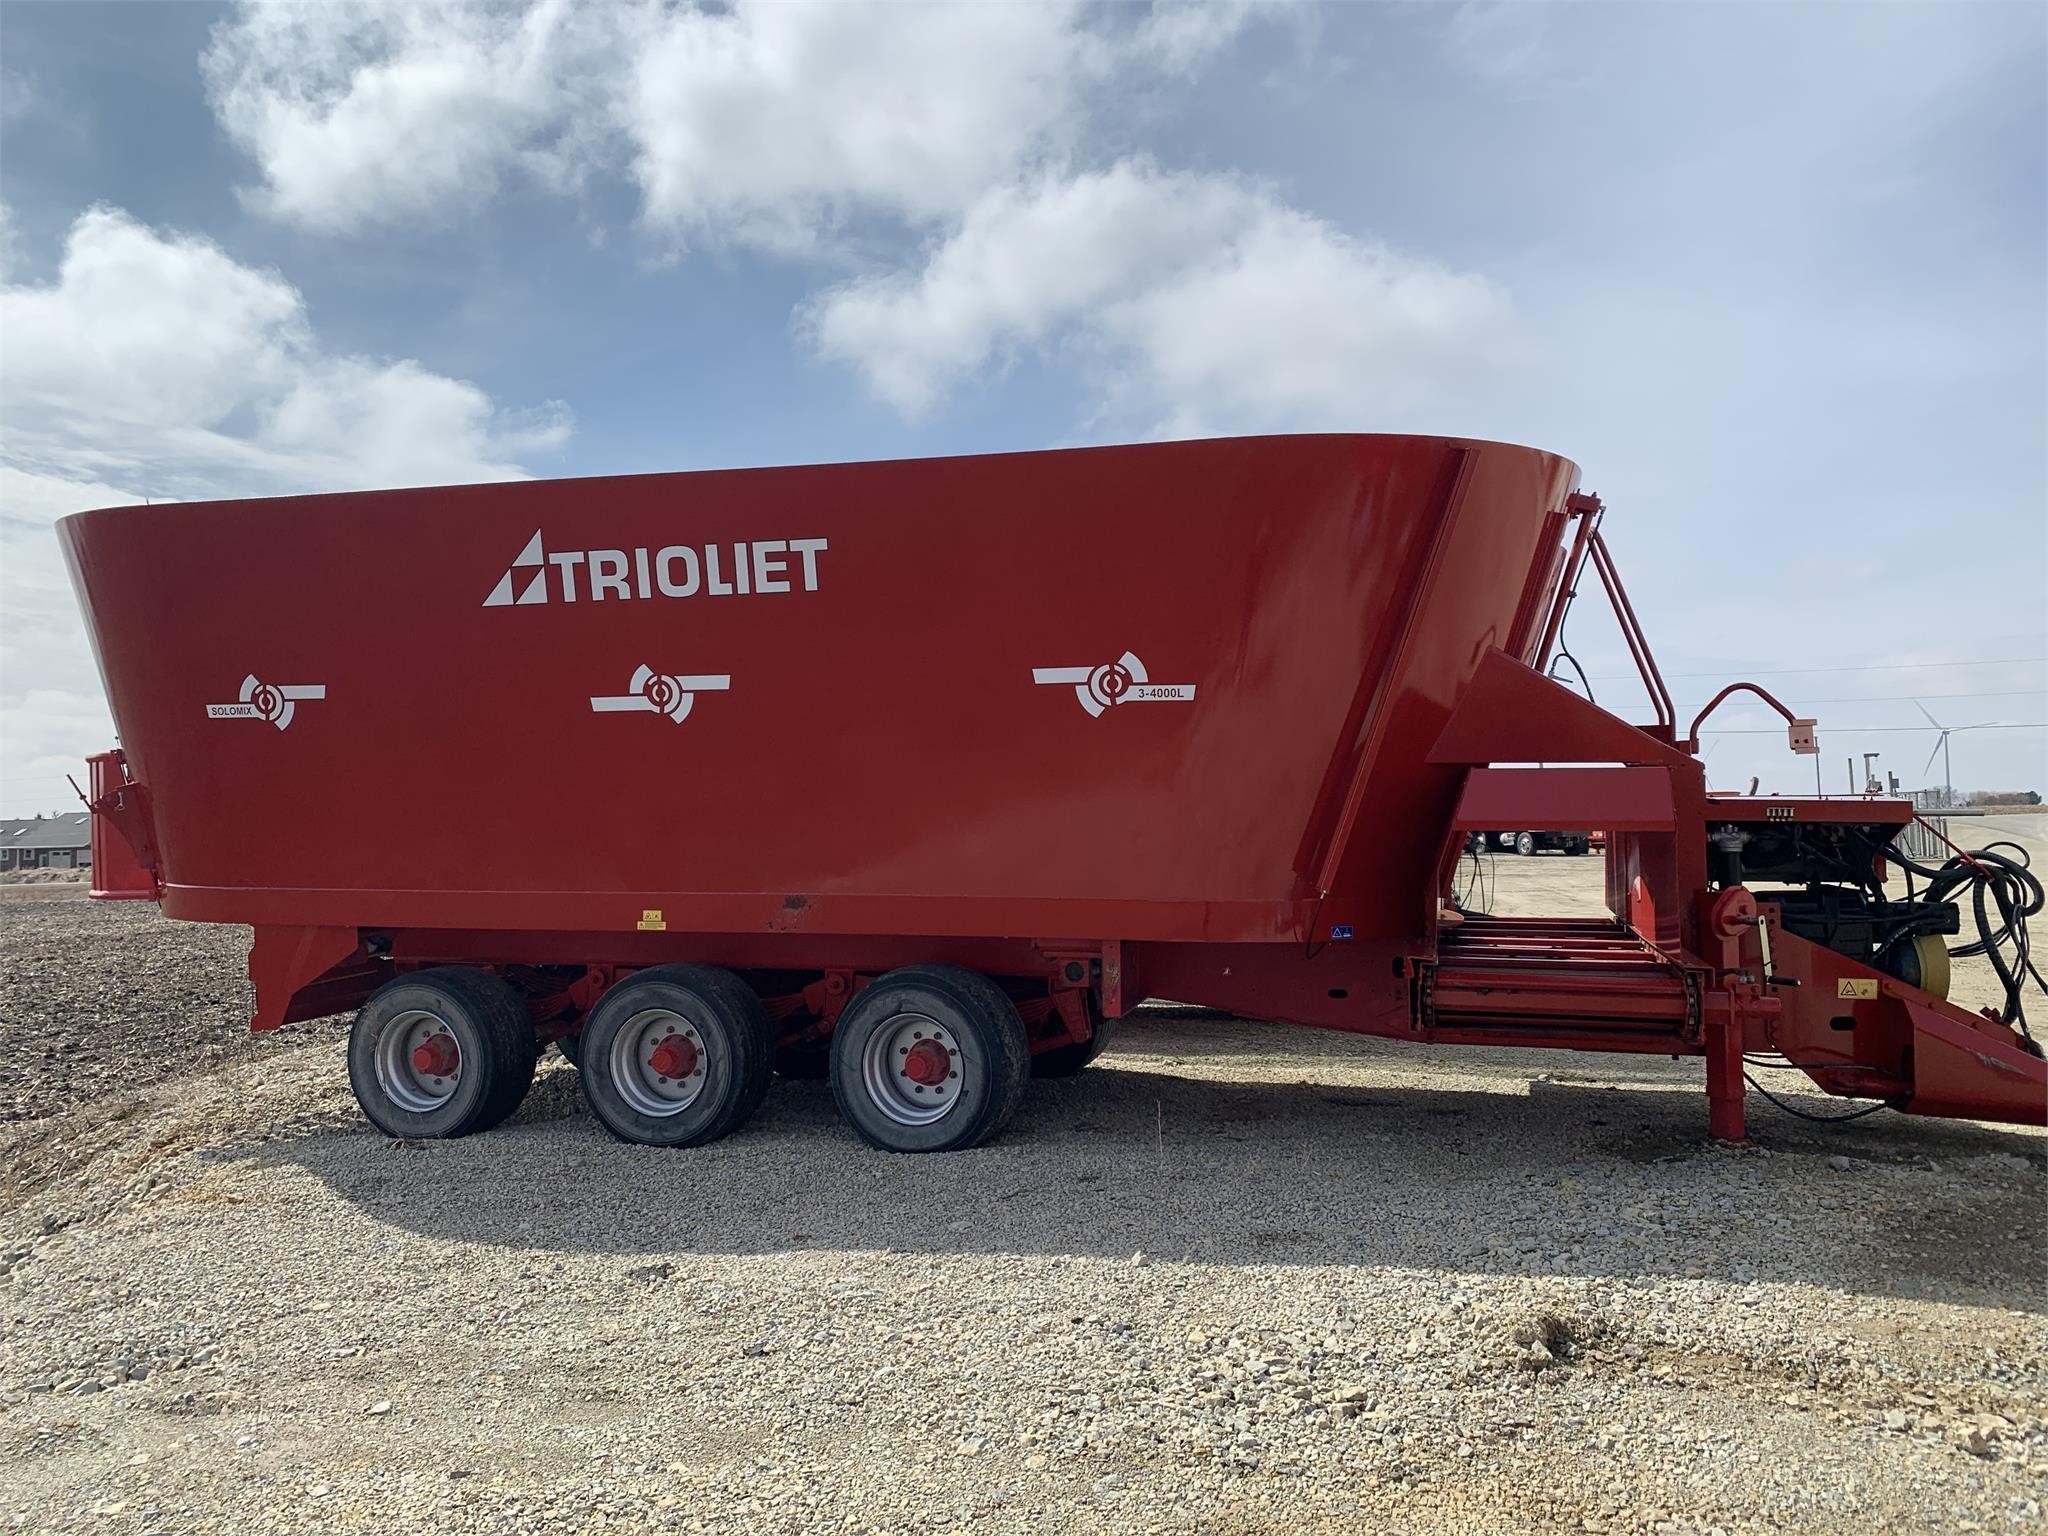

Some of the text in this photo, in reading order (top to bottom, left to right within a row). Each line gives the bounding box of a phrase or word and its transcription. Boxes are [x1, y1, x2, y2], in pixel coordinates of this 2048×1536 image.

[548, 538, 828, 602] TRIOLIET
[1138, 688, 1185, 698] 3-4000L
[211, 706, 253, 716] SOLOMIX
